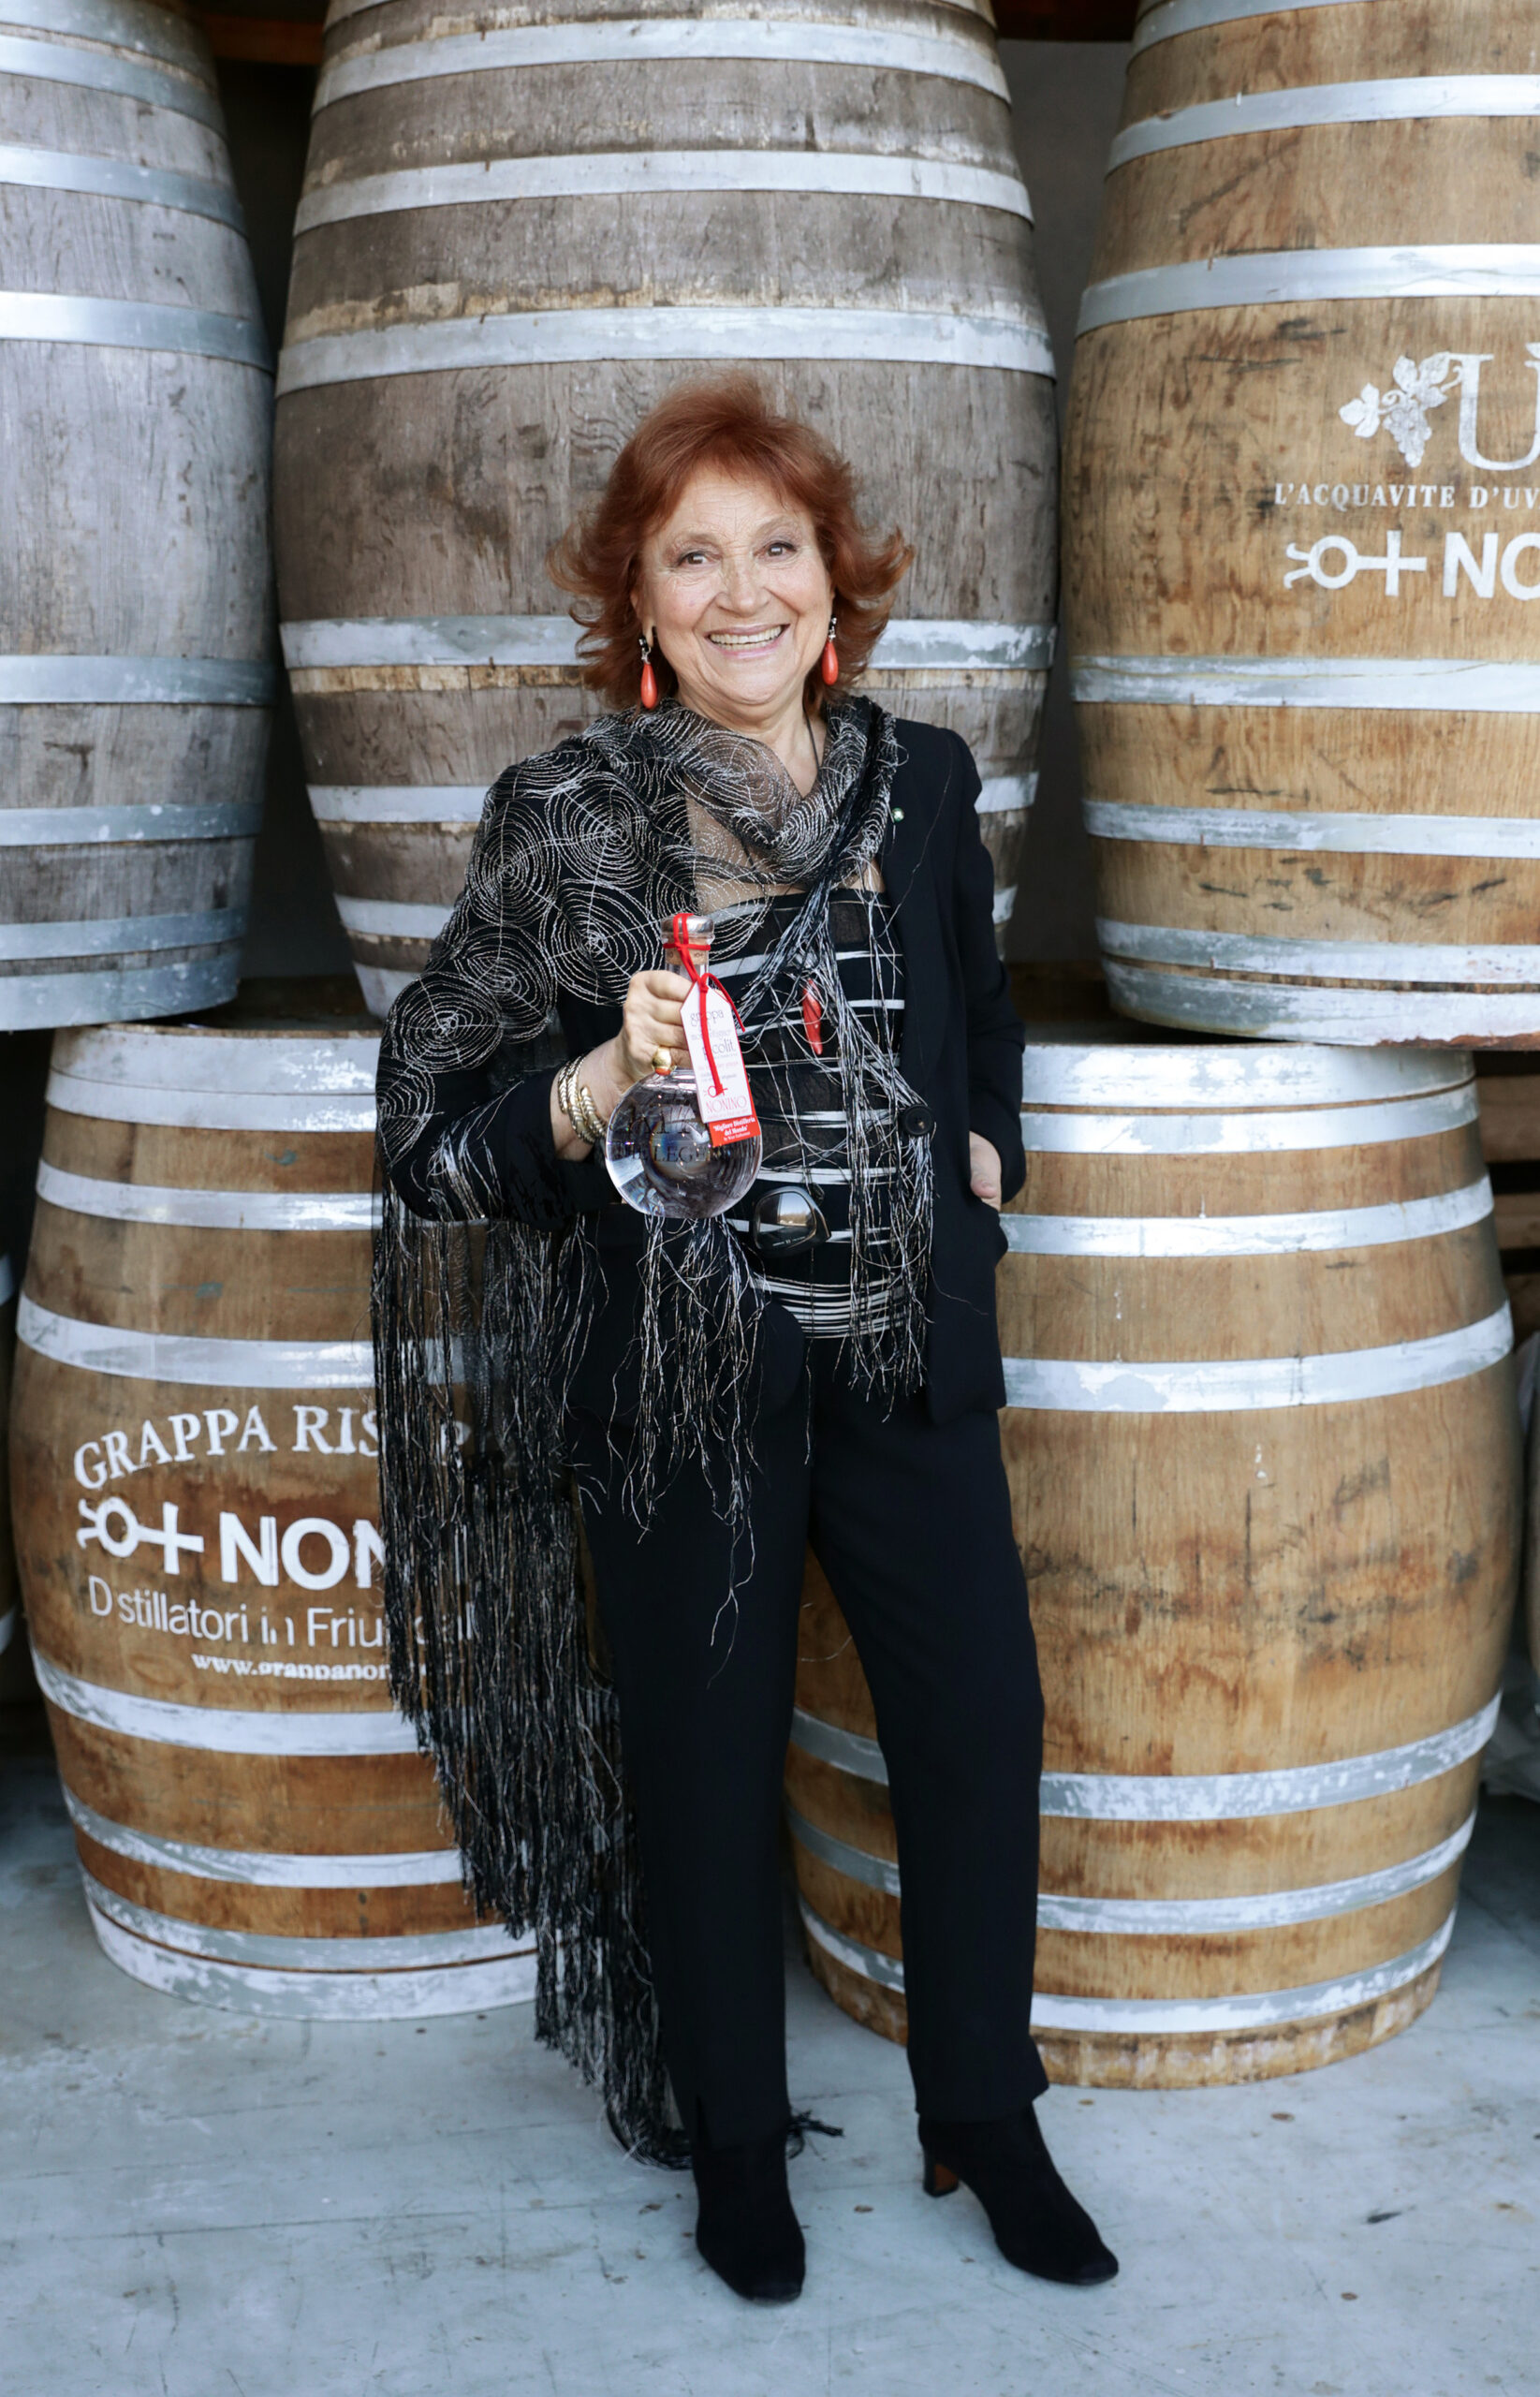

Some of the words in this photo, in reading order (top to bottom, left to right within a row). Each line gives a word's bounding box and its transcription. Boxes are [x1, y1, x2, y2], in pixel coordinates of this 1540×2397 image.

[1274, 483, 1455, 512] L'ACQUAVITE
[1469, 486, 1540, 509] D'UV
[690, 1009, 725, 1027] grppa
[703, 1038, 737, 1061] colit
[706, 1096, 747, 1113] NONINO
[73, 1404, 278, 1491] GRAPPA
[220, 1510, 387, 1591] NON
[88, 1575, 249, 1644] Dstillatori
